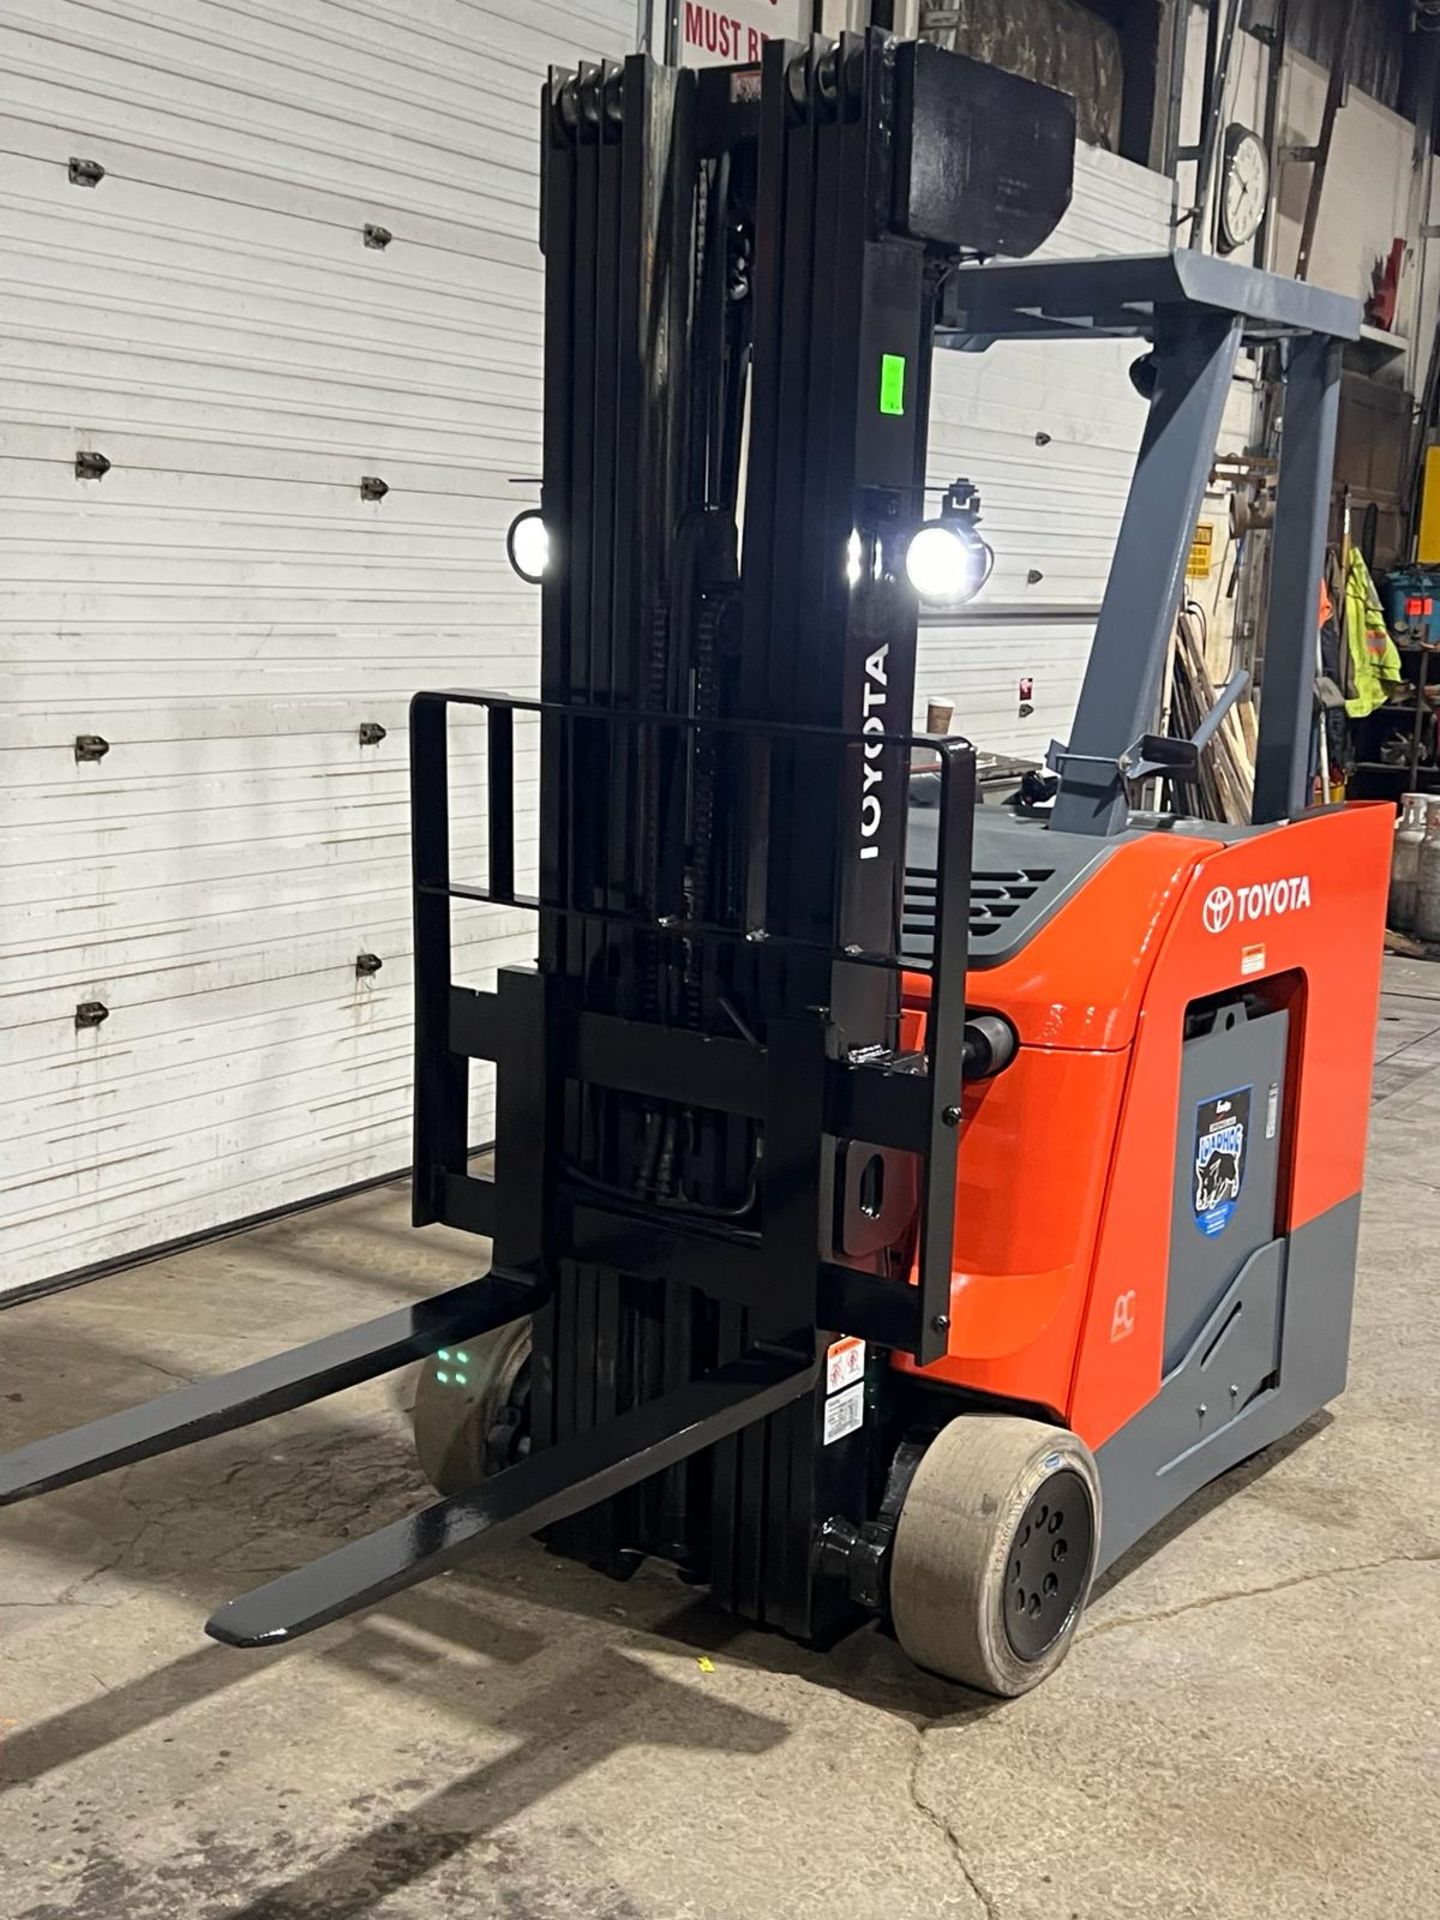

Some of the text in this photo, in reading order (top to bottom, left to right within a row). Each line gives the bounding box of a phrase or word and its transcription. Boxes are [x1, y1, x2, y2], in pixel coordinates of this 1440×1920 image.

[685, 1, 769, 63] MUST B
[1237, 875, 1311, 922] TOYOTA
